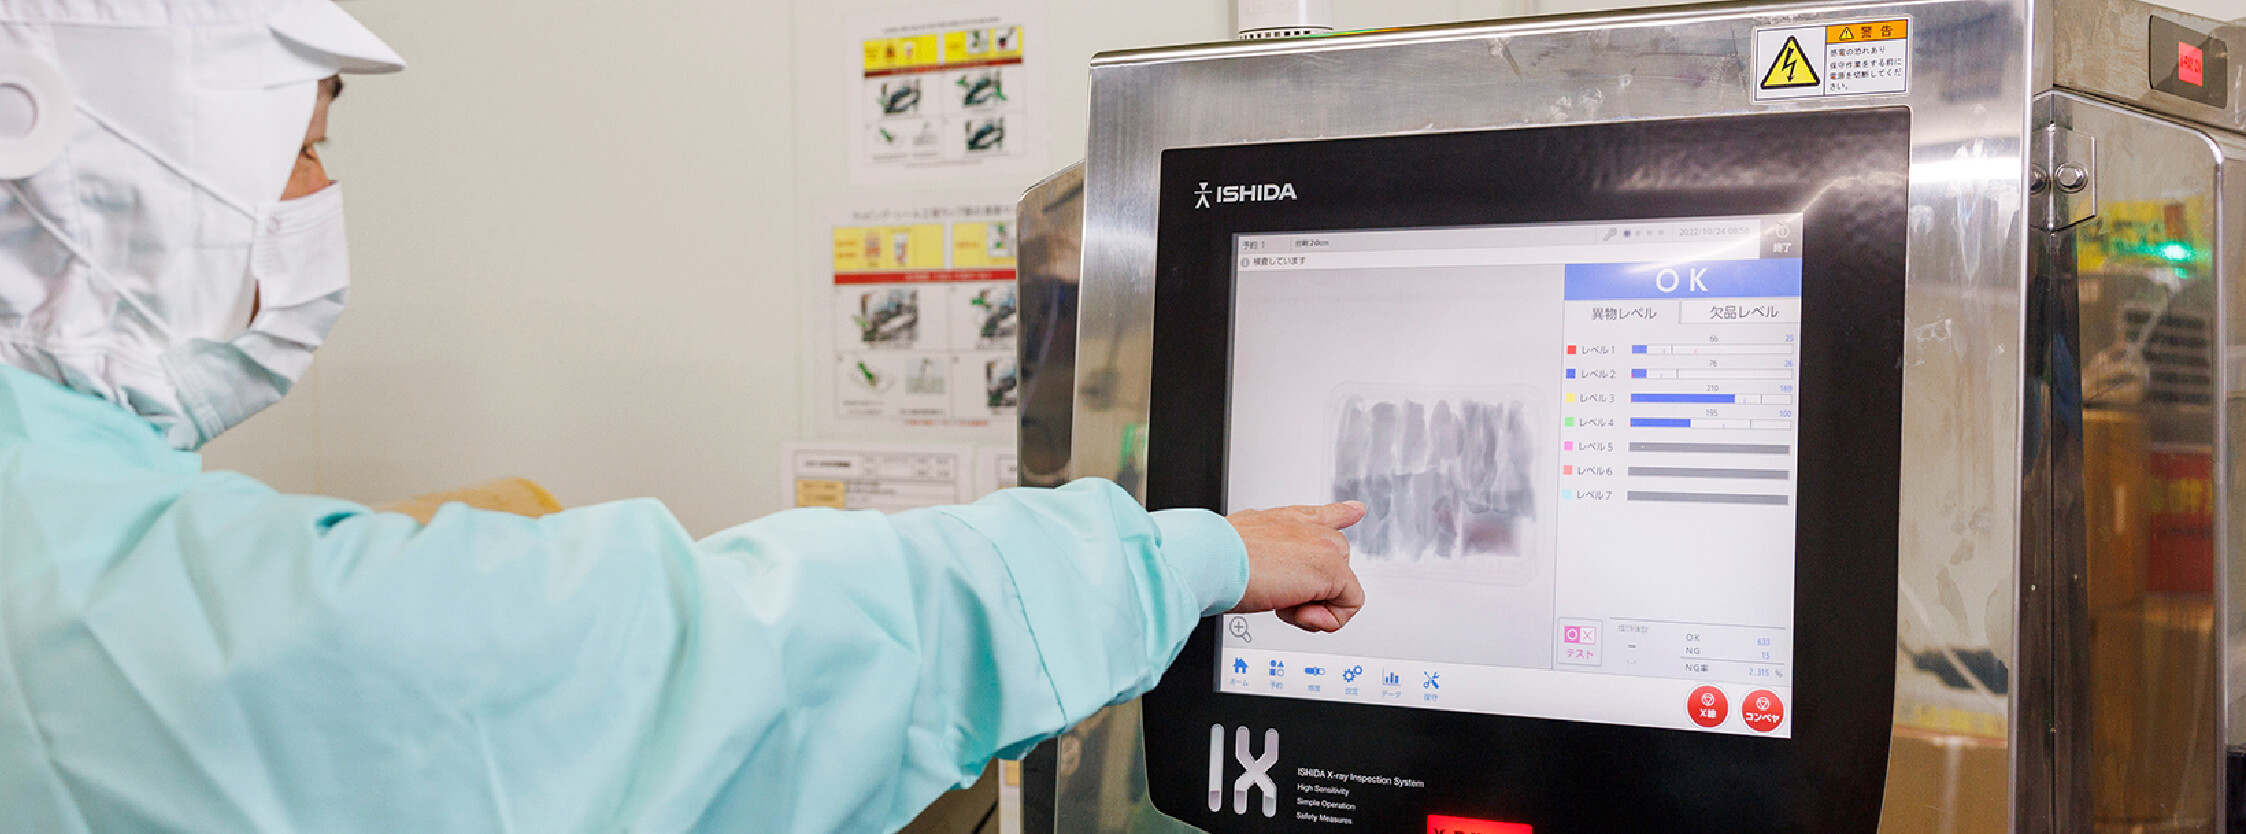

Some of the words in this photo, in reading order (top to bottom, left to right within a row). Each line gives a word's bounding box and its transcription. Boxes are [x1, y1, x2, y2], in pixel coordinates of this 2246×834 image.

[1861, 24, 1893, 39] 警告
[1216, 182, 1297, 203] ISHIDA
[1656, 268, 1708, 293] OK
[1592, 307, 1657, 320] 異物レベル
[1709, 305, 1779, 319] 欠品レベル
[1686, 633, 1700, 642] OK
[1567, 649, 1594, 658] テスト
[1686, 647, 1700, 655] NG
[1381, 690, 1402, 698] データ
[1745, 713, 1780, 723] コンベヤ
[1208, 723, 1279, 817] IX
[1297, 767, 1325, 779] ISHIDA
[1327, 770, 1349, 783] X-ray
[1350, 773, 1391, 786] Inspection
[1394, 777, 1425, 788] System
[1297, 783, 1313, 793] High
[1314, 785, 1350, 797] Sensitivity
[1296, 797, 1320, 807] Simple
[1321, 800, 1356, 811] Operation
[1296, 812, 1318, 823] Safety
[1319, 815, 1353, 825] Measures
